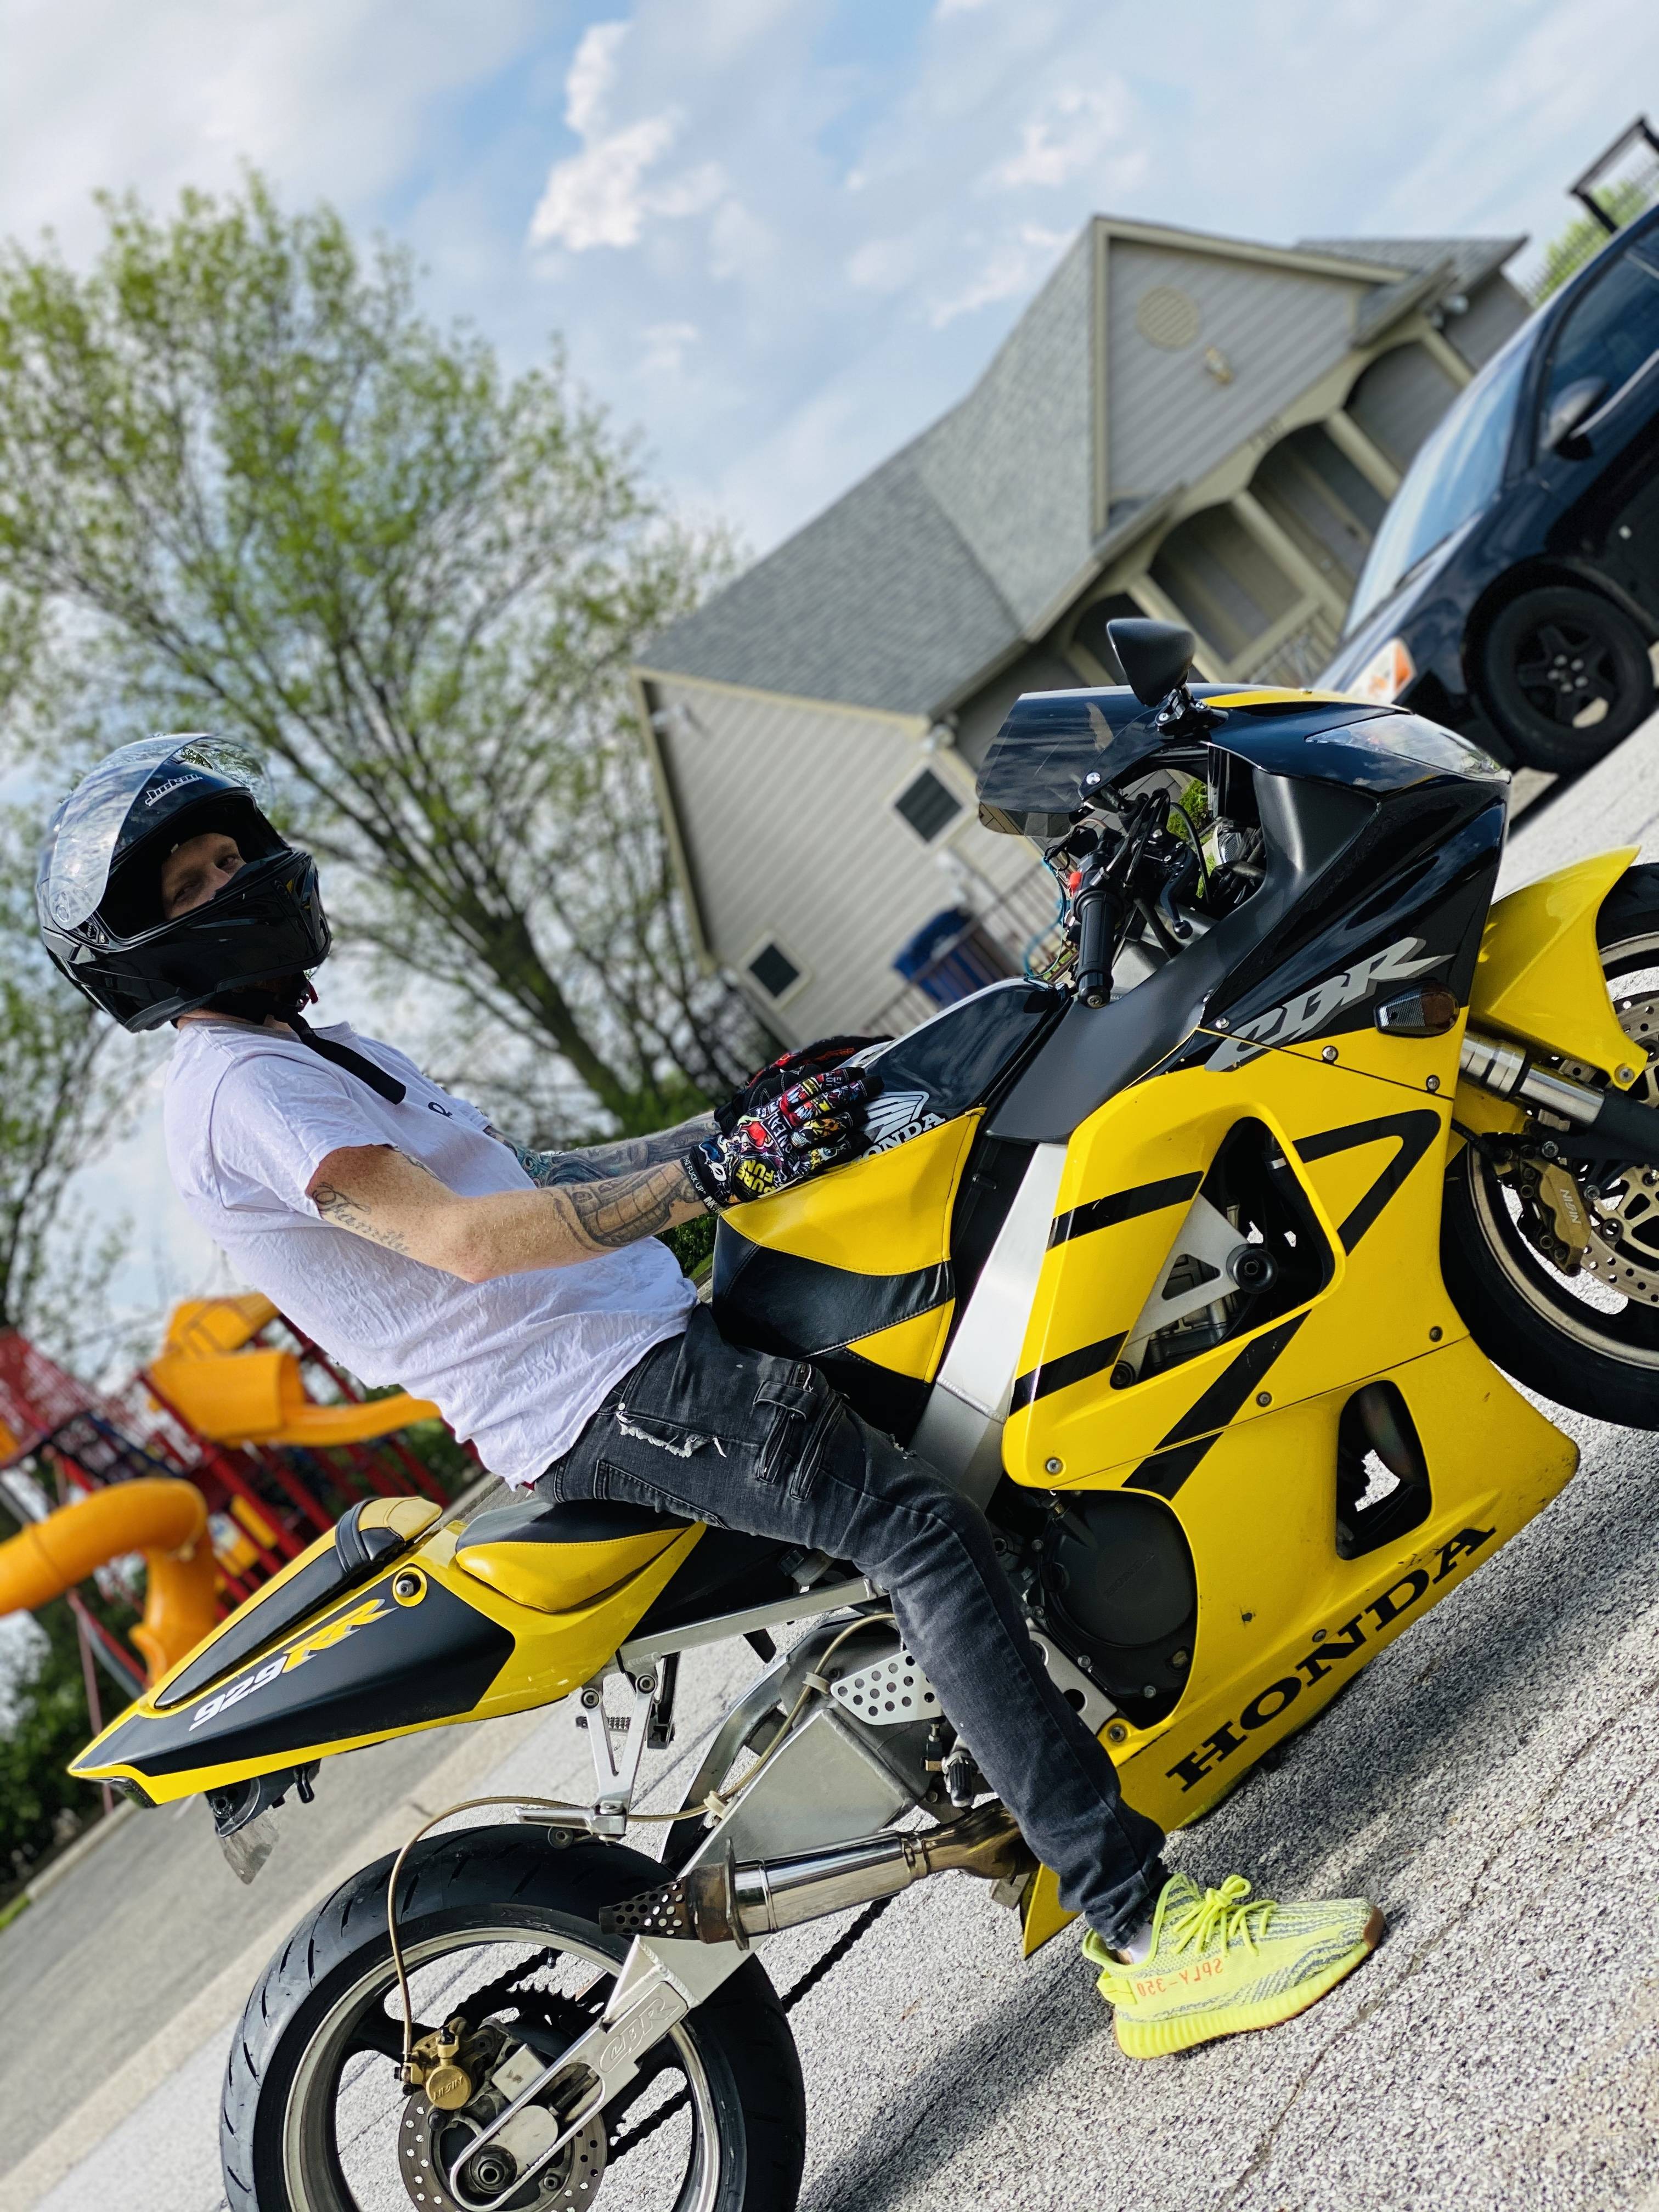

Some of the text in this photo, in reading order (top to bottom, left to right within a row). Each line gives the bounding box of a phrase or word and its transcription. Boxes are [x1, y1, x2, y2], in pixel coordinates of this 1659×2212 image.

[1204, 936, 1455, 1072] CBR
[743, 1159, 775, 1184] FUN
[861, 1113, 946, 1160] ONDA
[1165, 1526, 1497, 1793] HONDA
[598, 1995, 681, 2074] CBR
